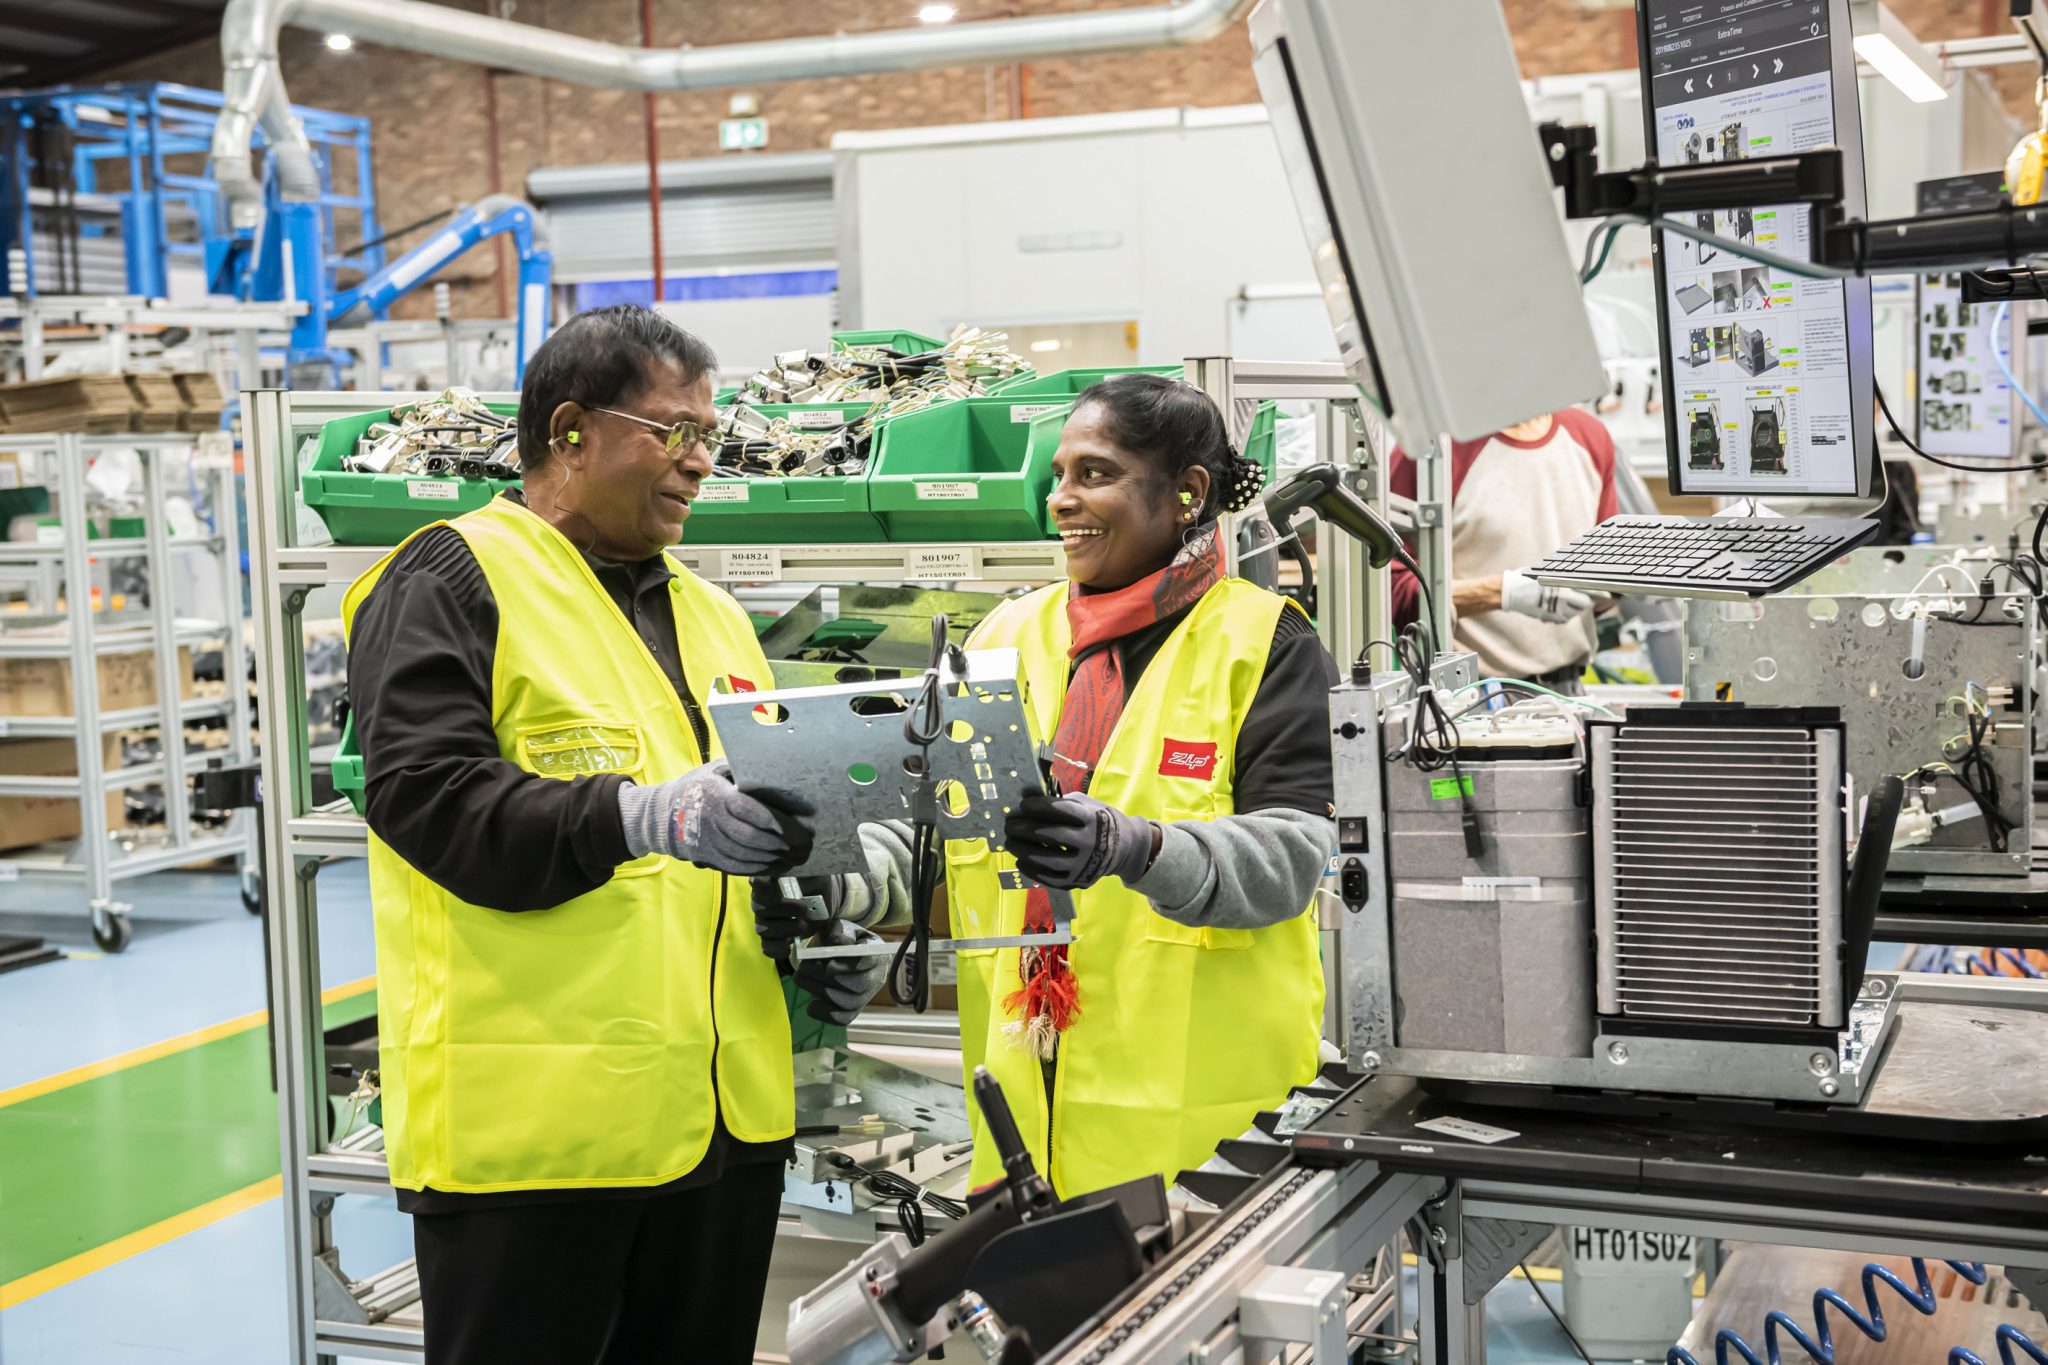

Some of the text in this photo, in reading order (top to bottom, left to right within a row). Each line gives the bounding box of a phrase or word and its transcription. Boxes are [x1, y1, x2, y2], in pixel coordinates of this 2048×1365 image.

[1717, 27, 1743, 40] ExtraTime
[731, 552, 769, 560] 804824
[921, 553, 961, 562] 801907
[1574, 1227, 1691, 1262] HT01S02
